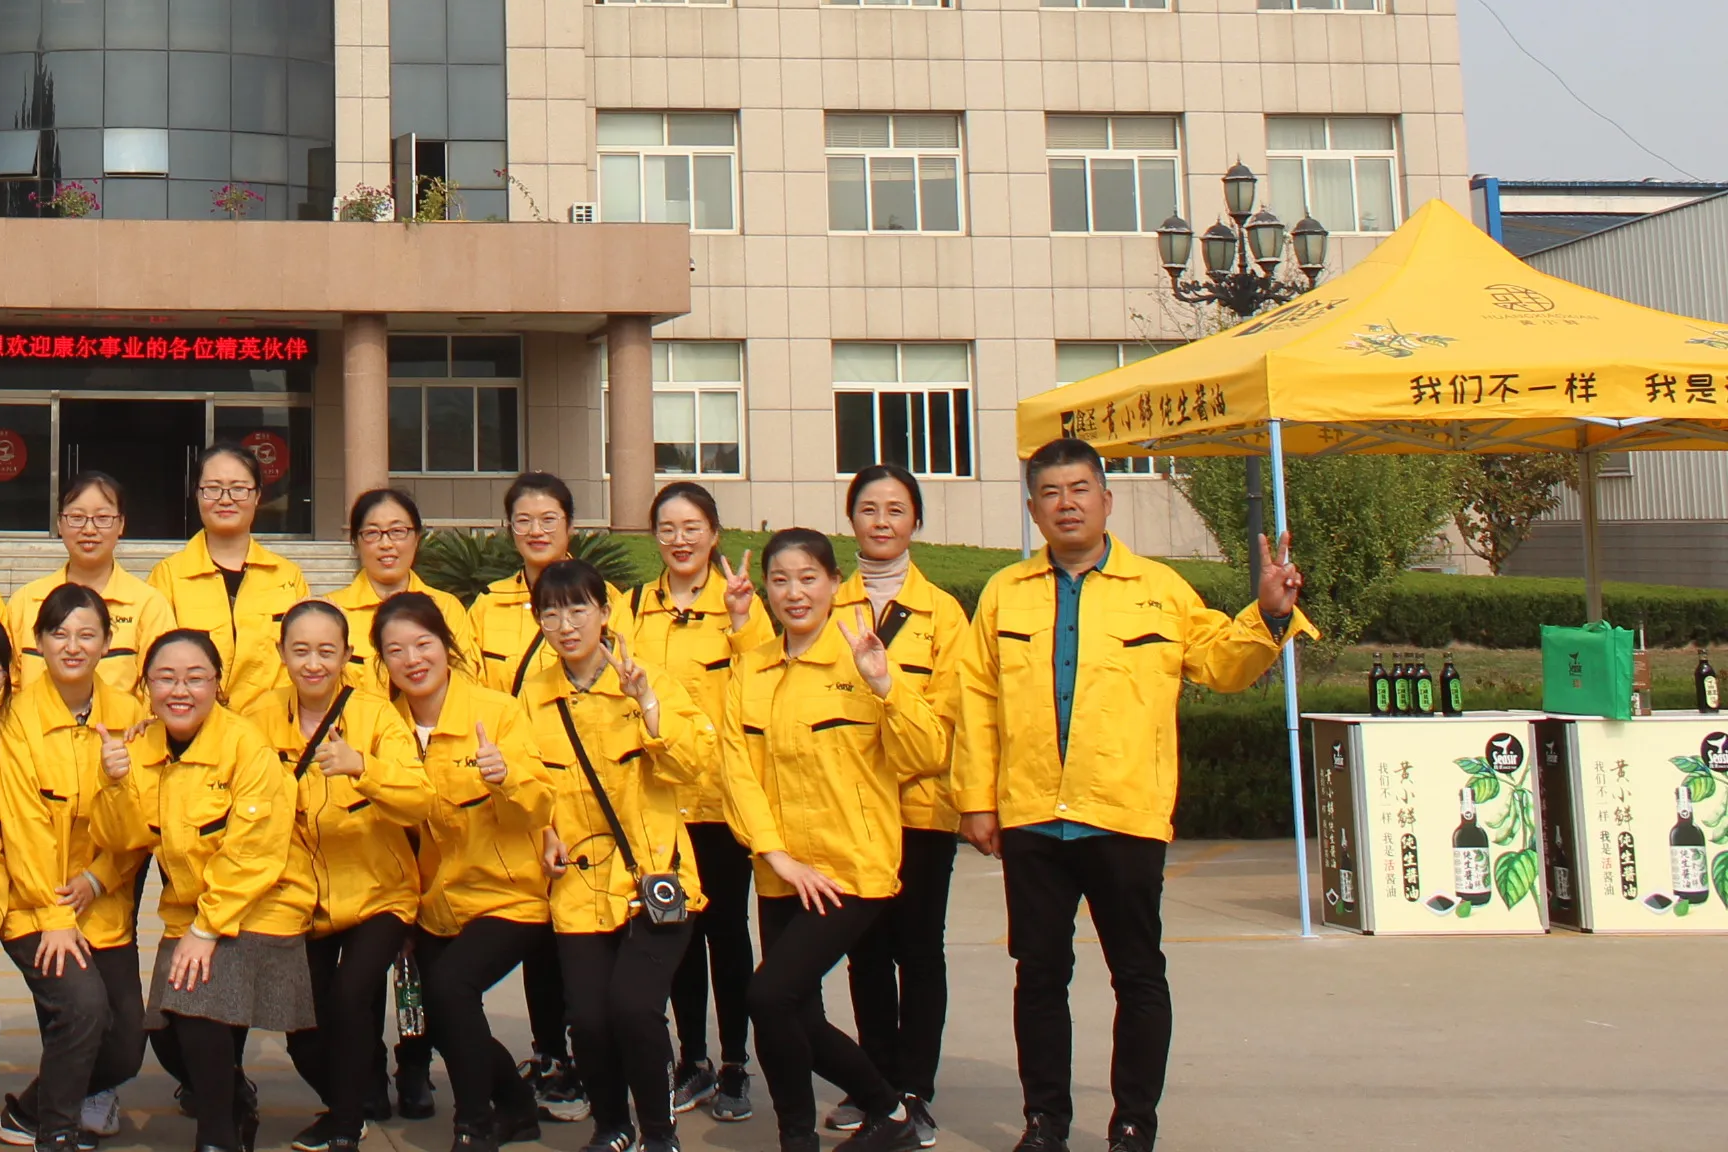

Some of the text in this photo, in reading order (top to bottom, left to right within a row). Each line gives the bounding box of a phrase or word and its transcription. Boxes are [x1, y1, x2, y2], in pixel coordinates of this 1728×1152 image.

[1409, 372, 1728, 405] 我们不一样 我是
